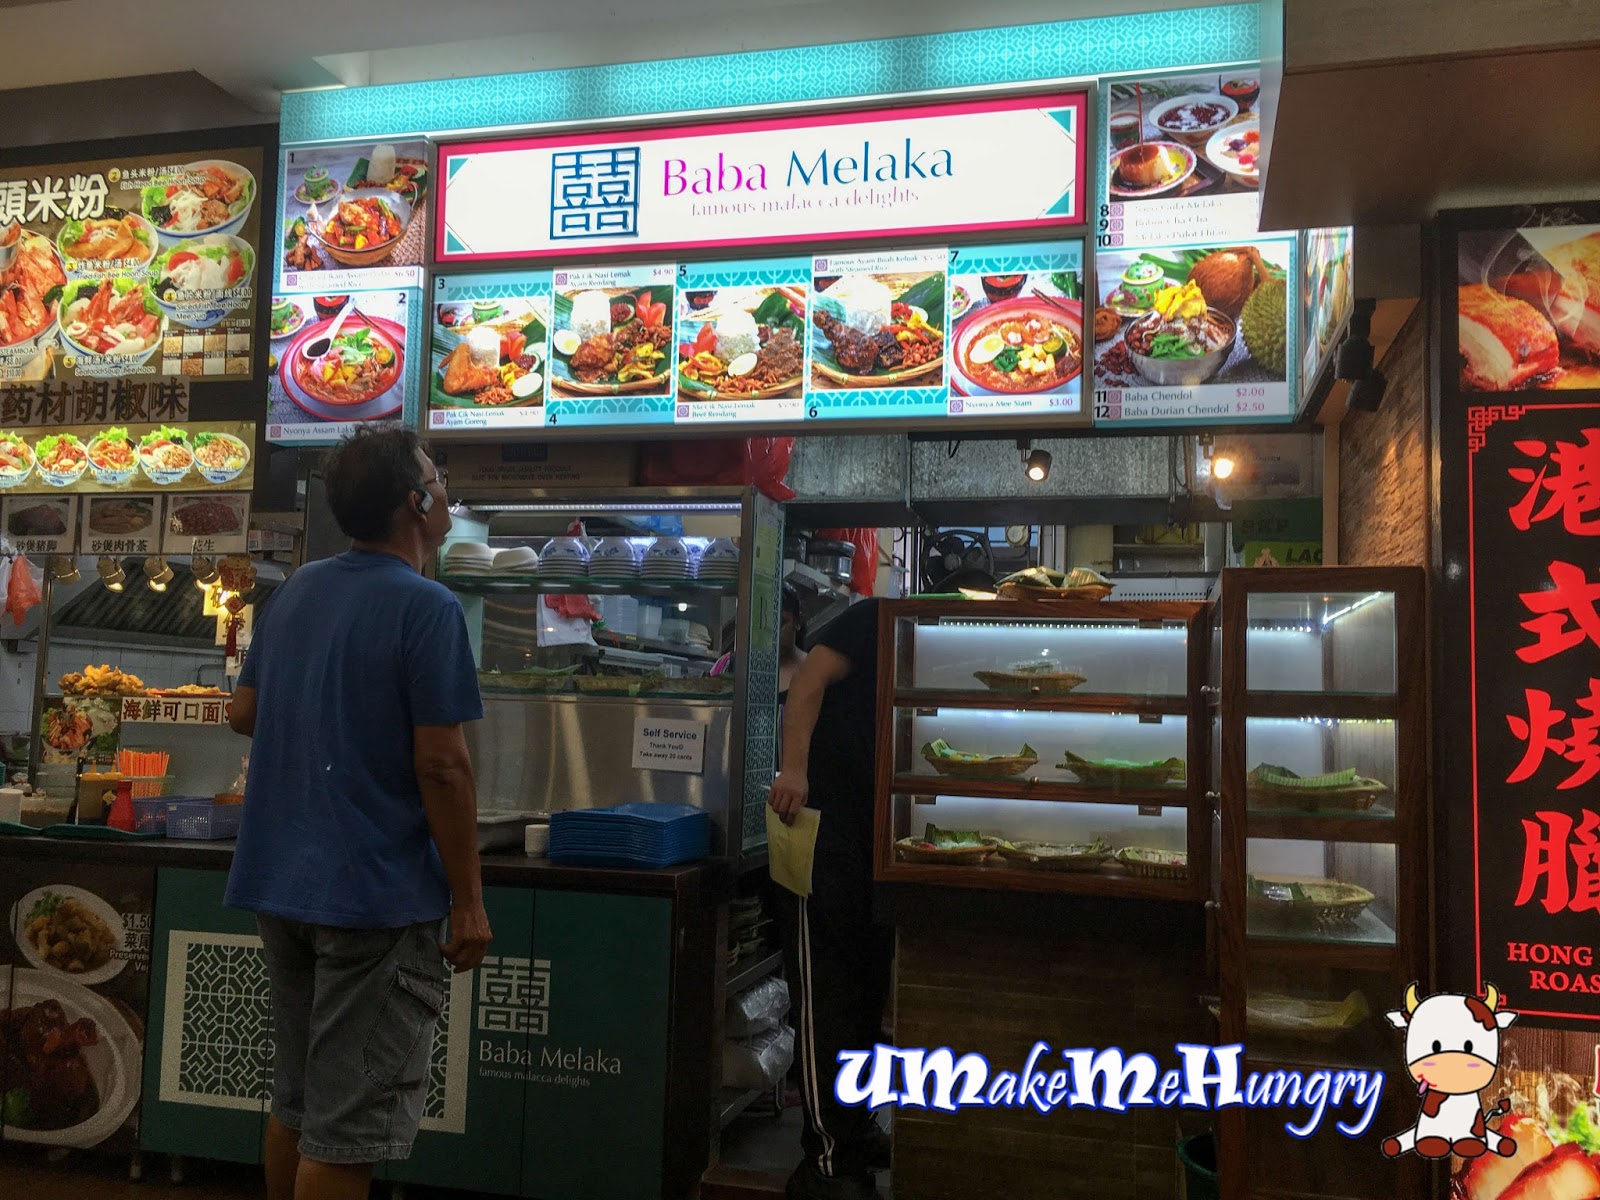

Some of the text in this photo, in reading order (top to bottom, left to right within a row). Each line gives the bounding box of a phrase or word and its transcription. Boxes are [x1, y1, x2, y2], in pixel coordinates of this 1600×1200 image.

[289, 152, 295, 163] 1
[664, 138, 953, 196] Baba Melaka
[693, 186, 919, 216] famous malacca delights
[1100, 205, 1109, 217] 8
[1100, 219, 1109, 231] 9
[1096, 235, 1111, 247] 10
[951, 250, 959, 262] 7
[679, 265, 687, 277] 5
[438, 279, 446, 289] 3
[398, 293, 407, 304] 2
[1095, 388, 1264, 402] 11 Baba Chendol $2.00
[996, 400, 1012, 408] Mee
[1014, 399, 1032, 407] Siam
[1049, 398, 1073, 407] $3.00
[809, 406, 818, 418] 6
[1095, 402, 1264, 418] 12 Baba Durian Chendol $2.50
[465, 418, 487, 426] Goreng
[549, 414, 558, 425] 4
[283, 426, 310, 435] Nyonya
[313, 426, 338, 435] Assam
[643, 728, 697, 740] Self Service
[1507, 942, 1593, 966] HONG
[1529, 970, 1600, 994] ROAS
[479, 1040, 621, 1074] Baba Melaka
[479, 1066, 591, 1088] famous malacca delights
